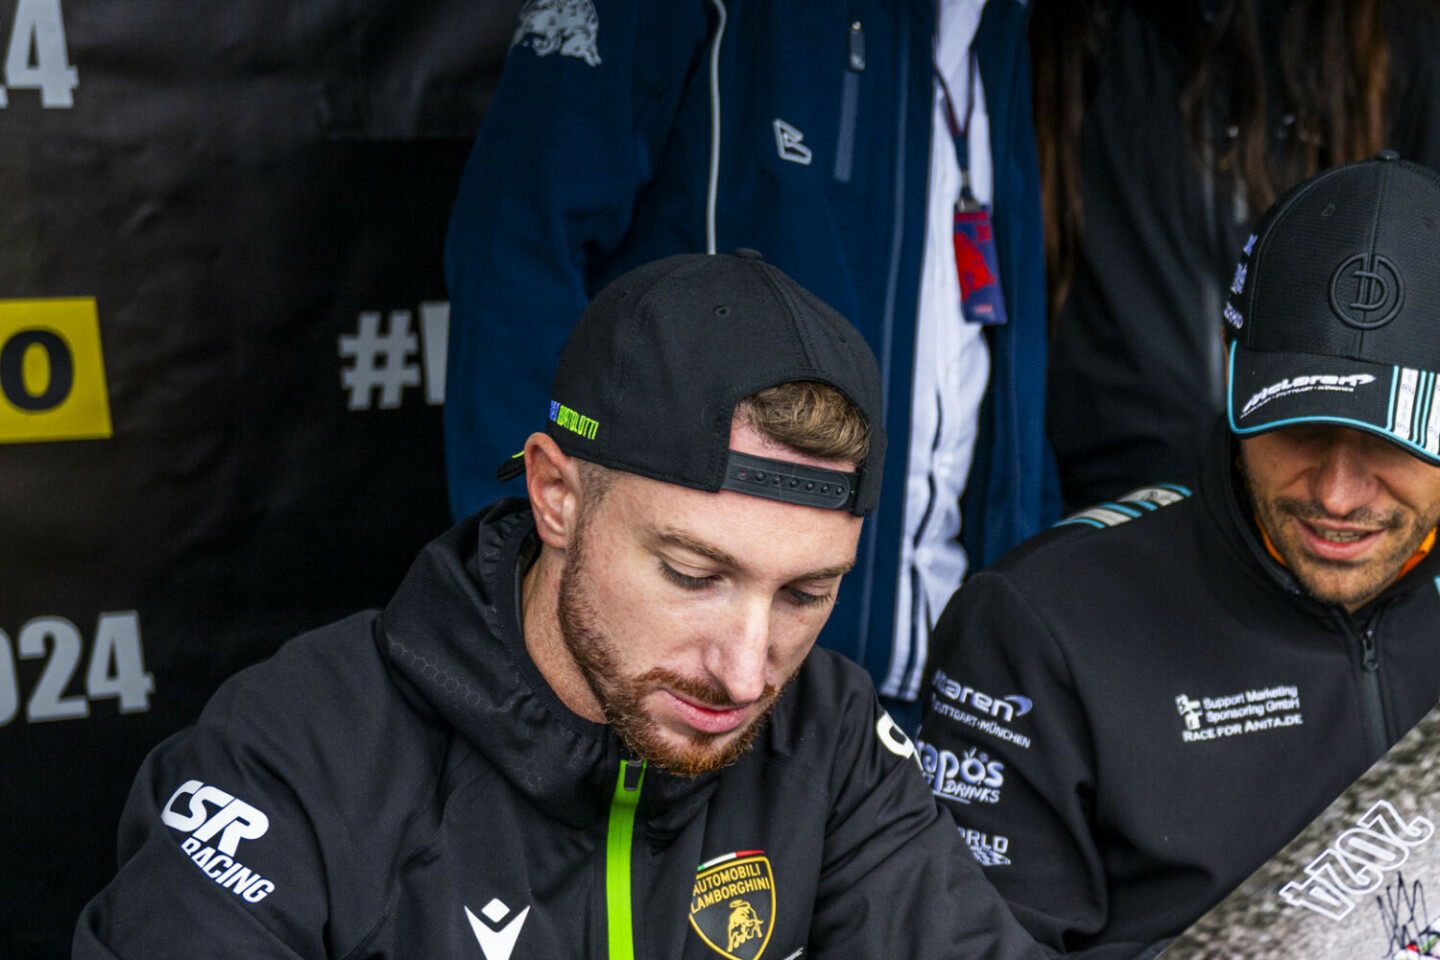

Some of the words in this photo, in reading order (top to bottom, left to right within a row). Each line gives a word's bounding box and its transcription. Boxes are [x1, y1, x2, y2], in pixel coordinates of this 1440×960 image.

[0, 0, 78, 107] 4
[1203, 693, 1245, 711] Support
[1246, 685, 1298, 703] Marketing
[1206, 704, 1265, 724] Sponsoring
[1265, 697, 1300, 713] GmbH
[1182, 727, 1217, 743] RACE
[1216, 723, 1243, 738] FOR
[943, 780, 1001, 804] DRINKS
[160, 779, 270, 857] CSR
[181, 836, 276, 903] RACING
[1278, 799, 1435, 922] 2024
[690, 876, 771, 914] LAMBORGHINI
[693, 863, 761, 897] AUTOMOBILI
